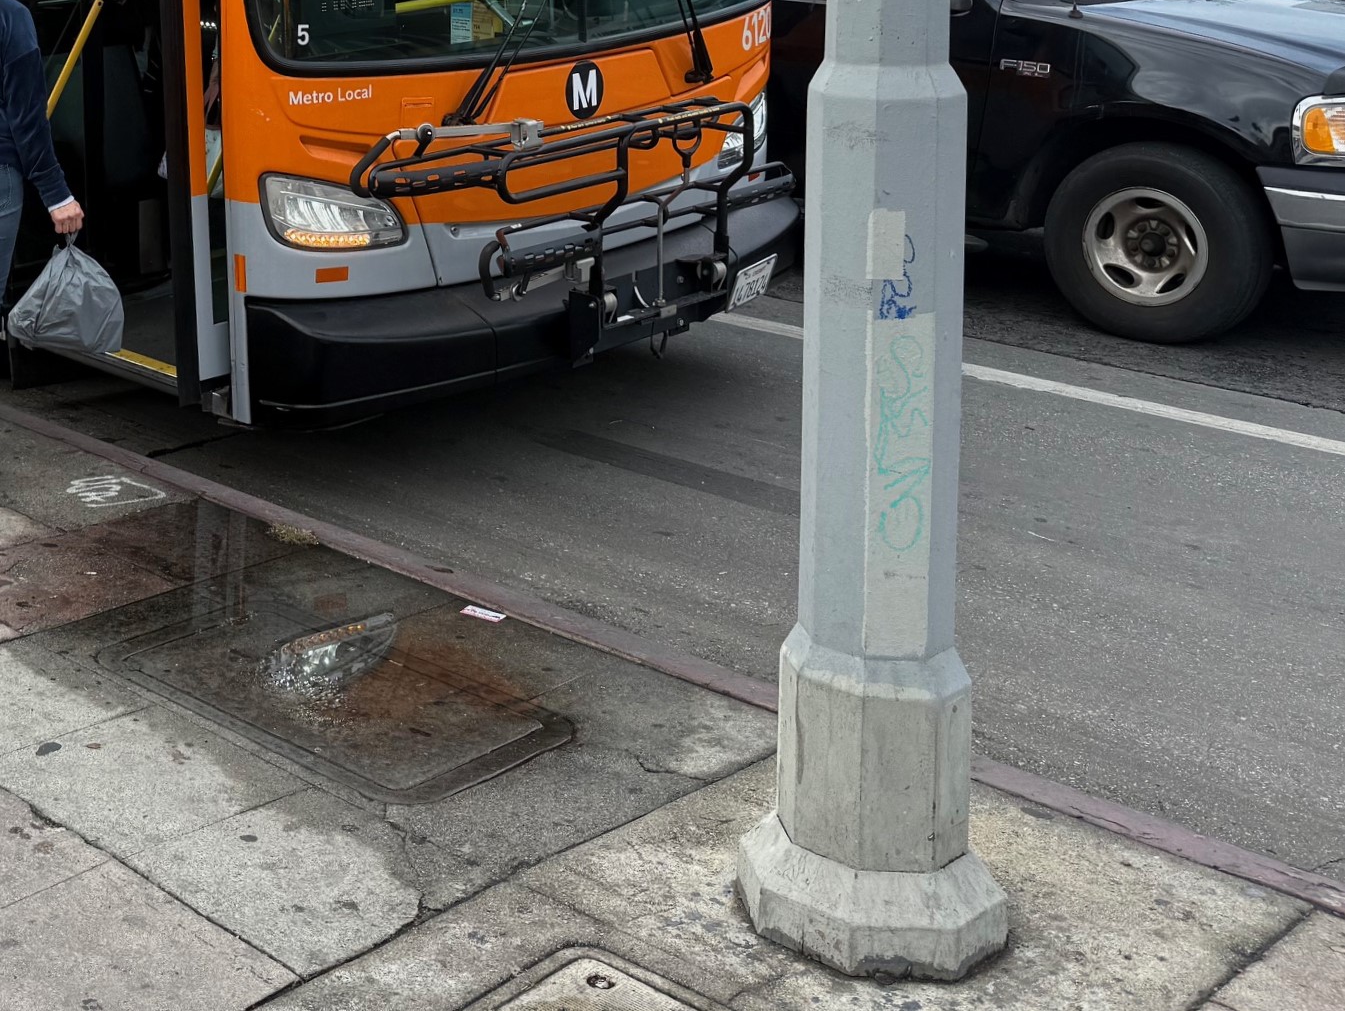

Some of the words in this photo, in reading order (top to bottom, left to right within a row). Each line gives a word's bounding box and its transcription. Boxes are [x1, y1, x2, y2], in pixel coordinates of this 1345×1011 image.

[297, 24, 310, 46] 5
[741, 6, 771, 51] 6120
[289, 90, 333, 105] Metro
[338, 84, 372, 101] Local
